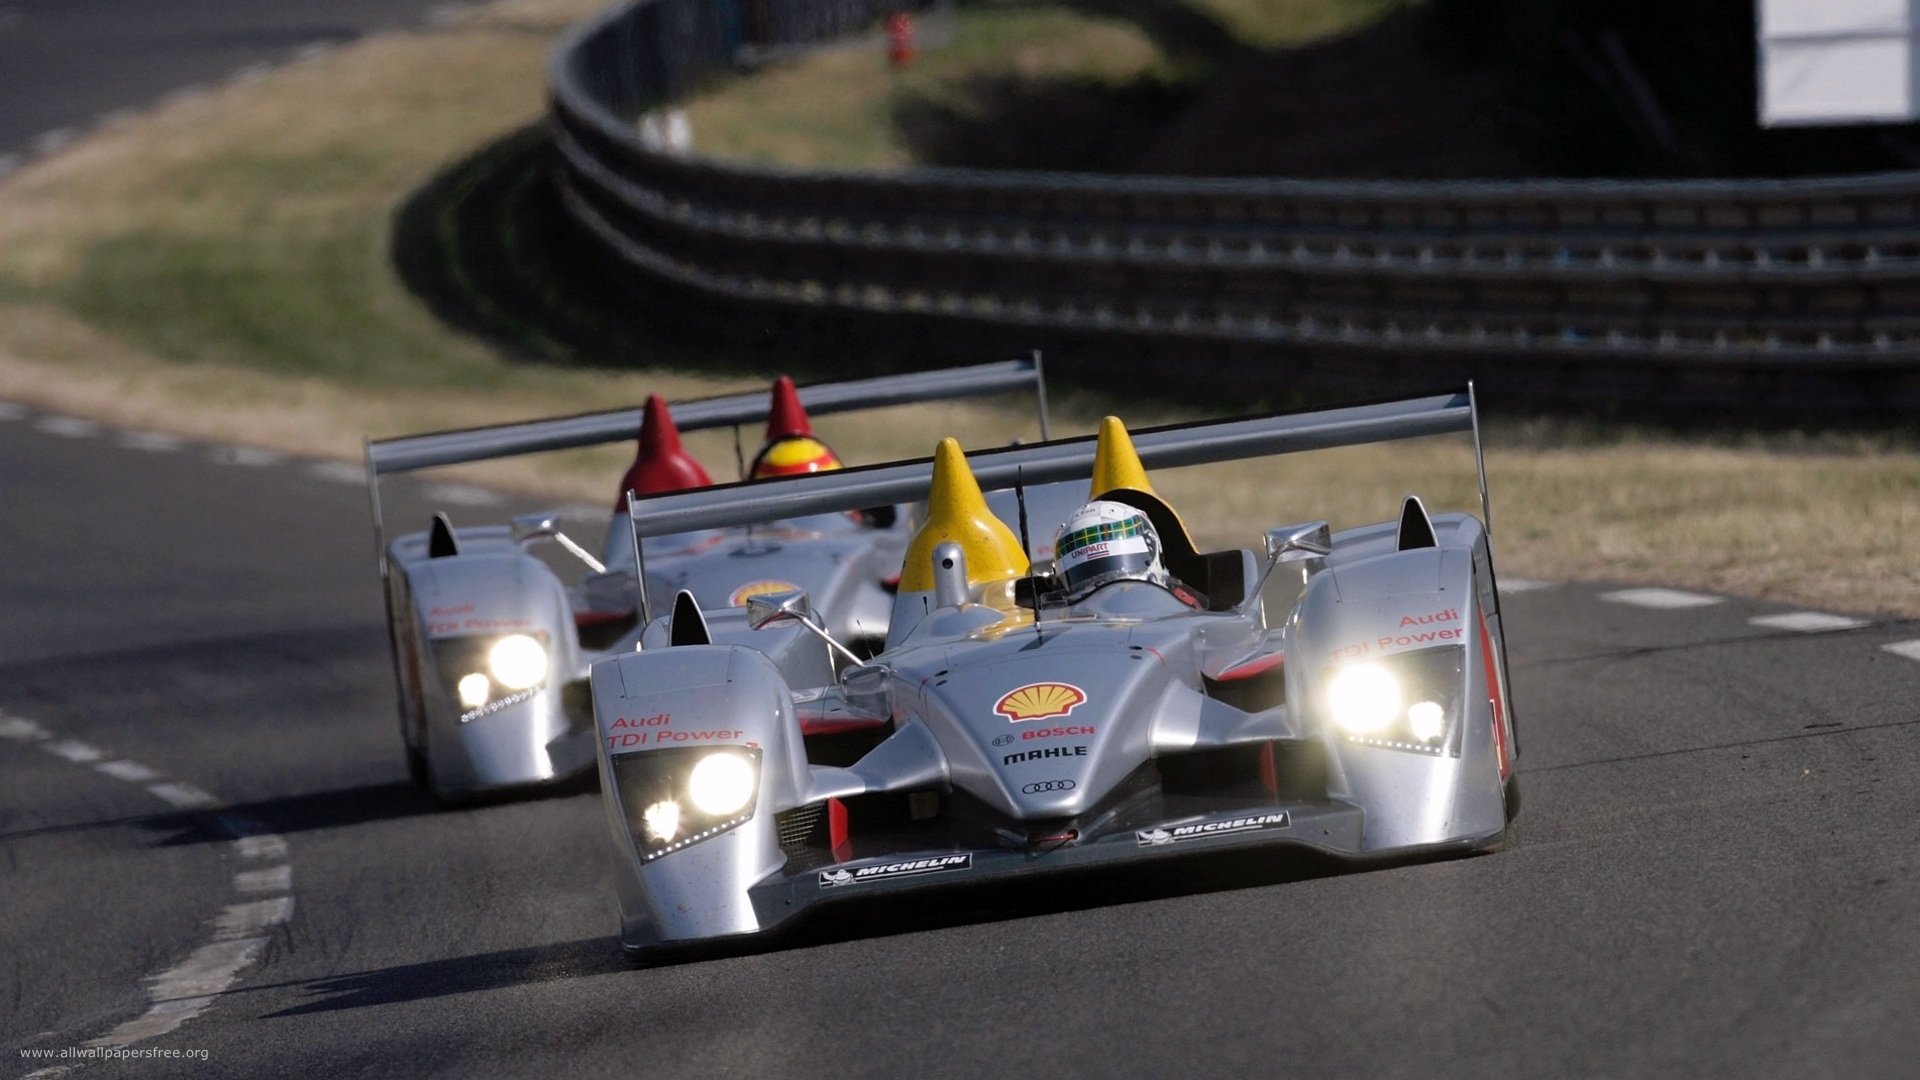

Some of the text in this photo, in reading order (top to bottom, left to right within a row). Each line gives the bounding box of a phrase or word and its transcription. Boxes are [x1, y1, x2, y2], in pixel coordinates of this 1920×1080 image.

[1071, 542, 1109, 560] UNIPART
[1398, 608, 1460, 628] Audi
[1328, 628, 1464, 662] TDI Power
[610, 713, 672, 730] Audi
[607, 729, 744, 749] TDI Power
[1022, 726, 1095, 741] BOSCH
[1003, 745, 1088, 766] MAHLE
[1173, 813, 1284, 836] MICHELIN
[855, 855, 967, 877] MICHELIN
